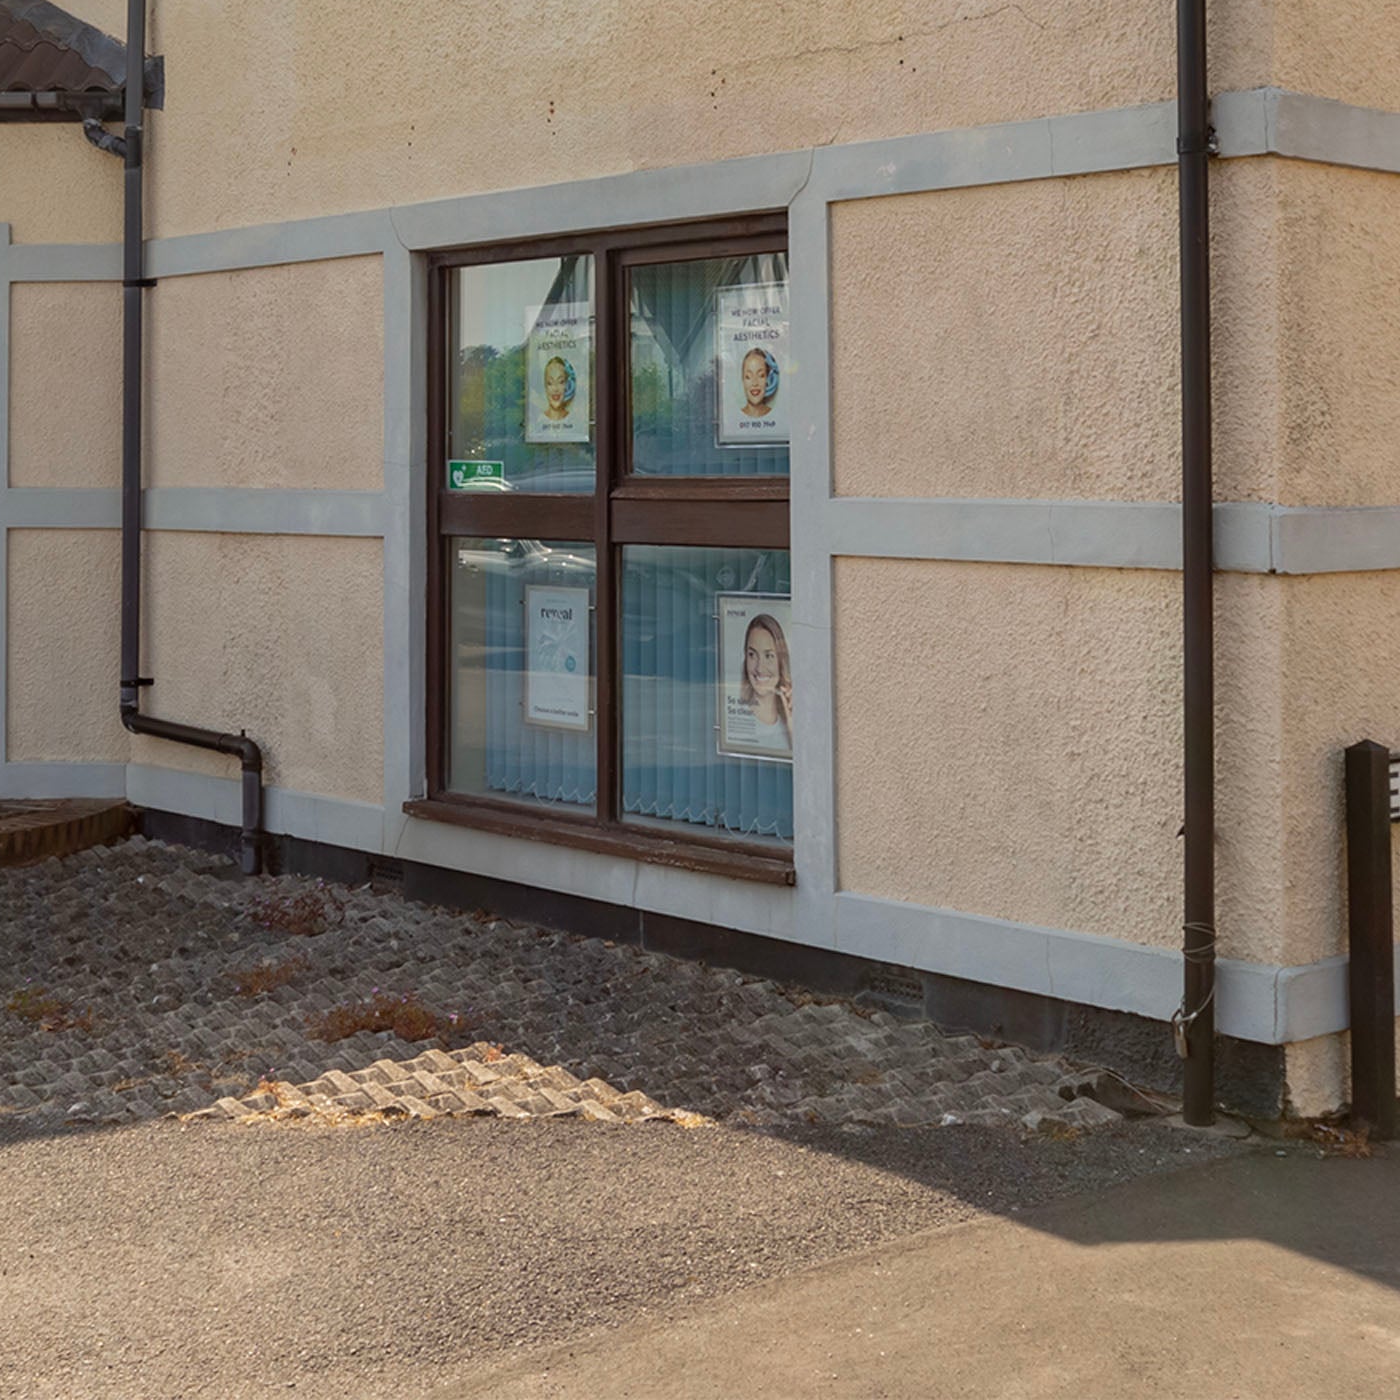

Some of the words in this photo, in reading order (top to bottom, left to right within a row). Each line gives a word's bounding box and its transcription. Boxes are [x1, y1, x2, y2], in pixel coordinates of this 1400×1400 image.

[742, 318, 771, 328] FACIAL
[733, 330, 781, 342] AESTHETICS
[476, 464, 493, 476] AED
[540, 607, 573, 621] reveal
